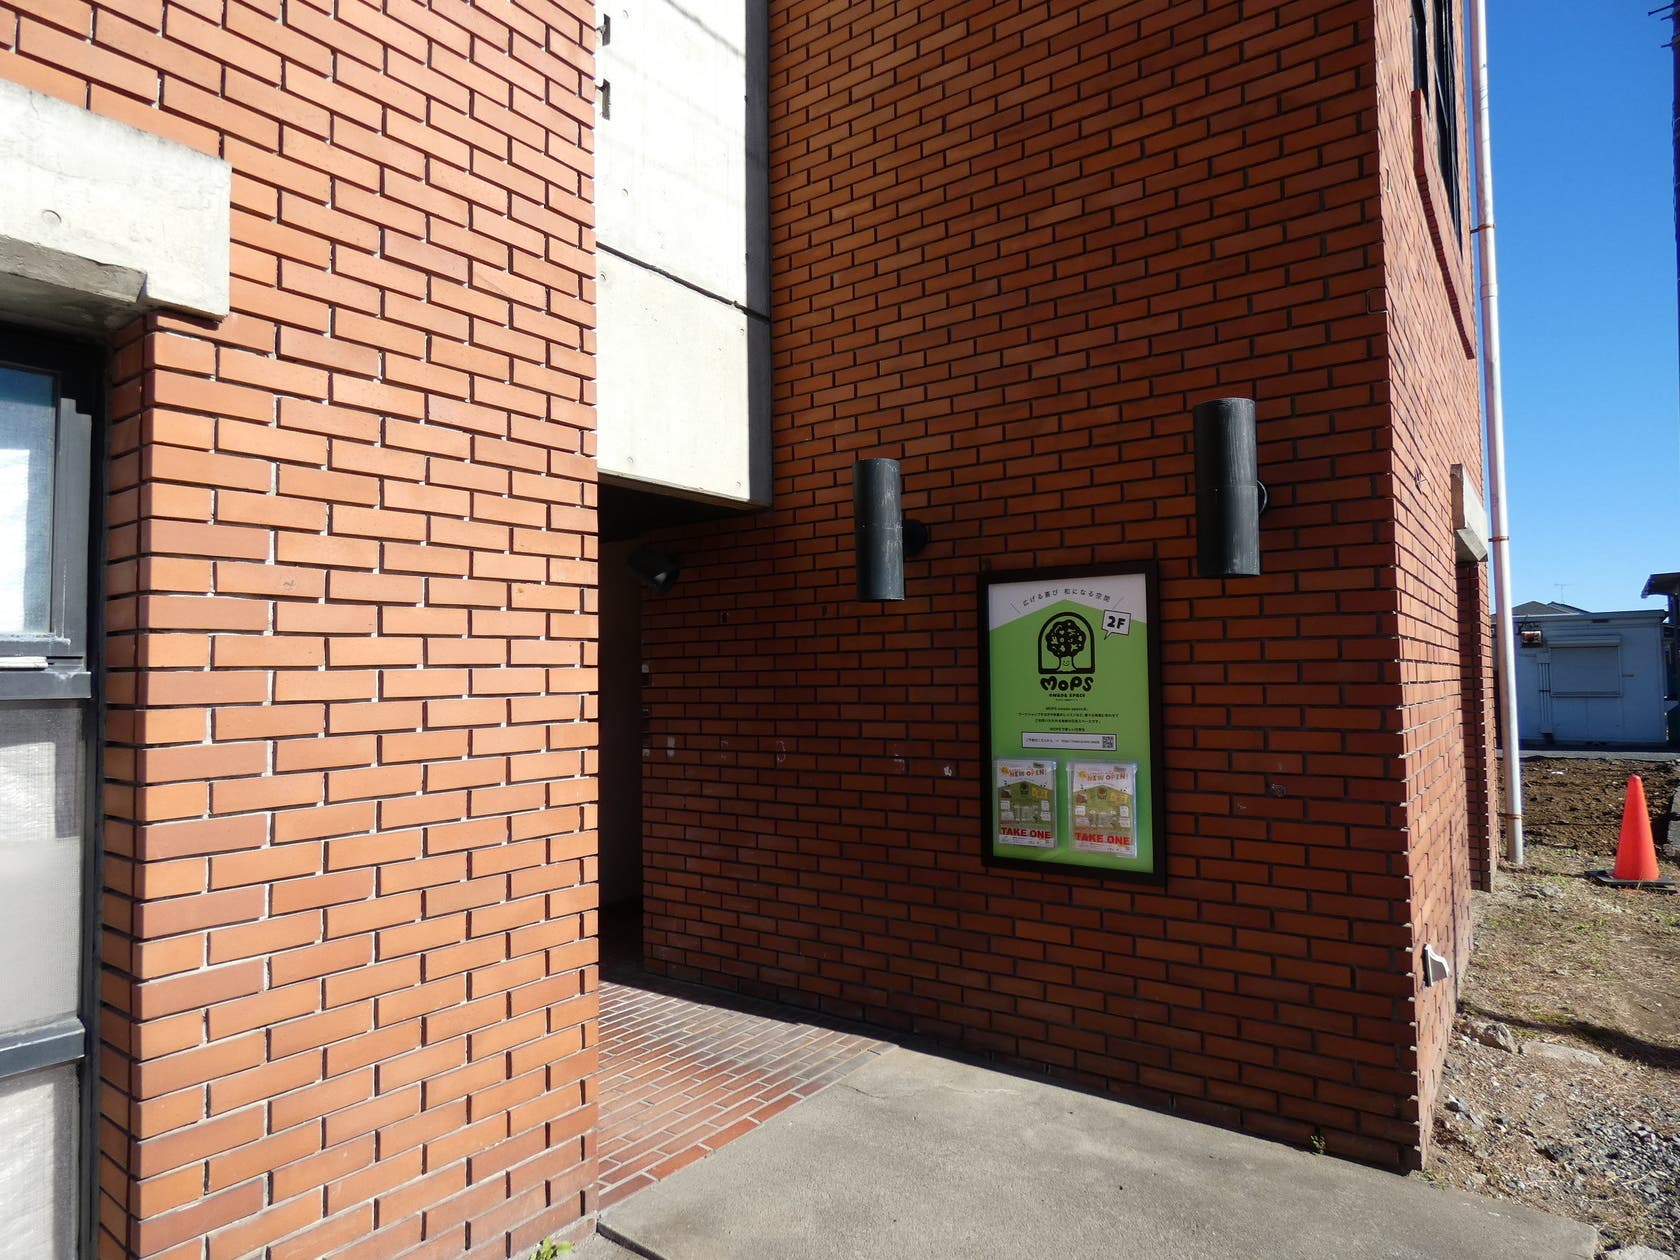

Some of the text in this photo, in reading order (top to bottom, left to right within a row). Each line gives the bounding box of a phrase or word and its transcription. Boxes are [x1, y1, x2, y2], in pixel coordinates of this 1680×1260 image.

[1107, 616, 1126, 629] 2F
[1087, 774, 1104, 782] NEW
[1001, 827, 1052, 839] TAKE ONE
[1074, 832, 1131, 845] TAKE ONE
